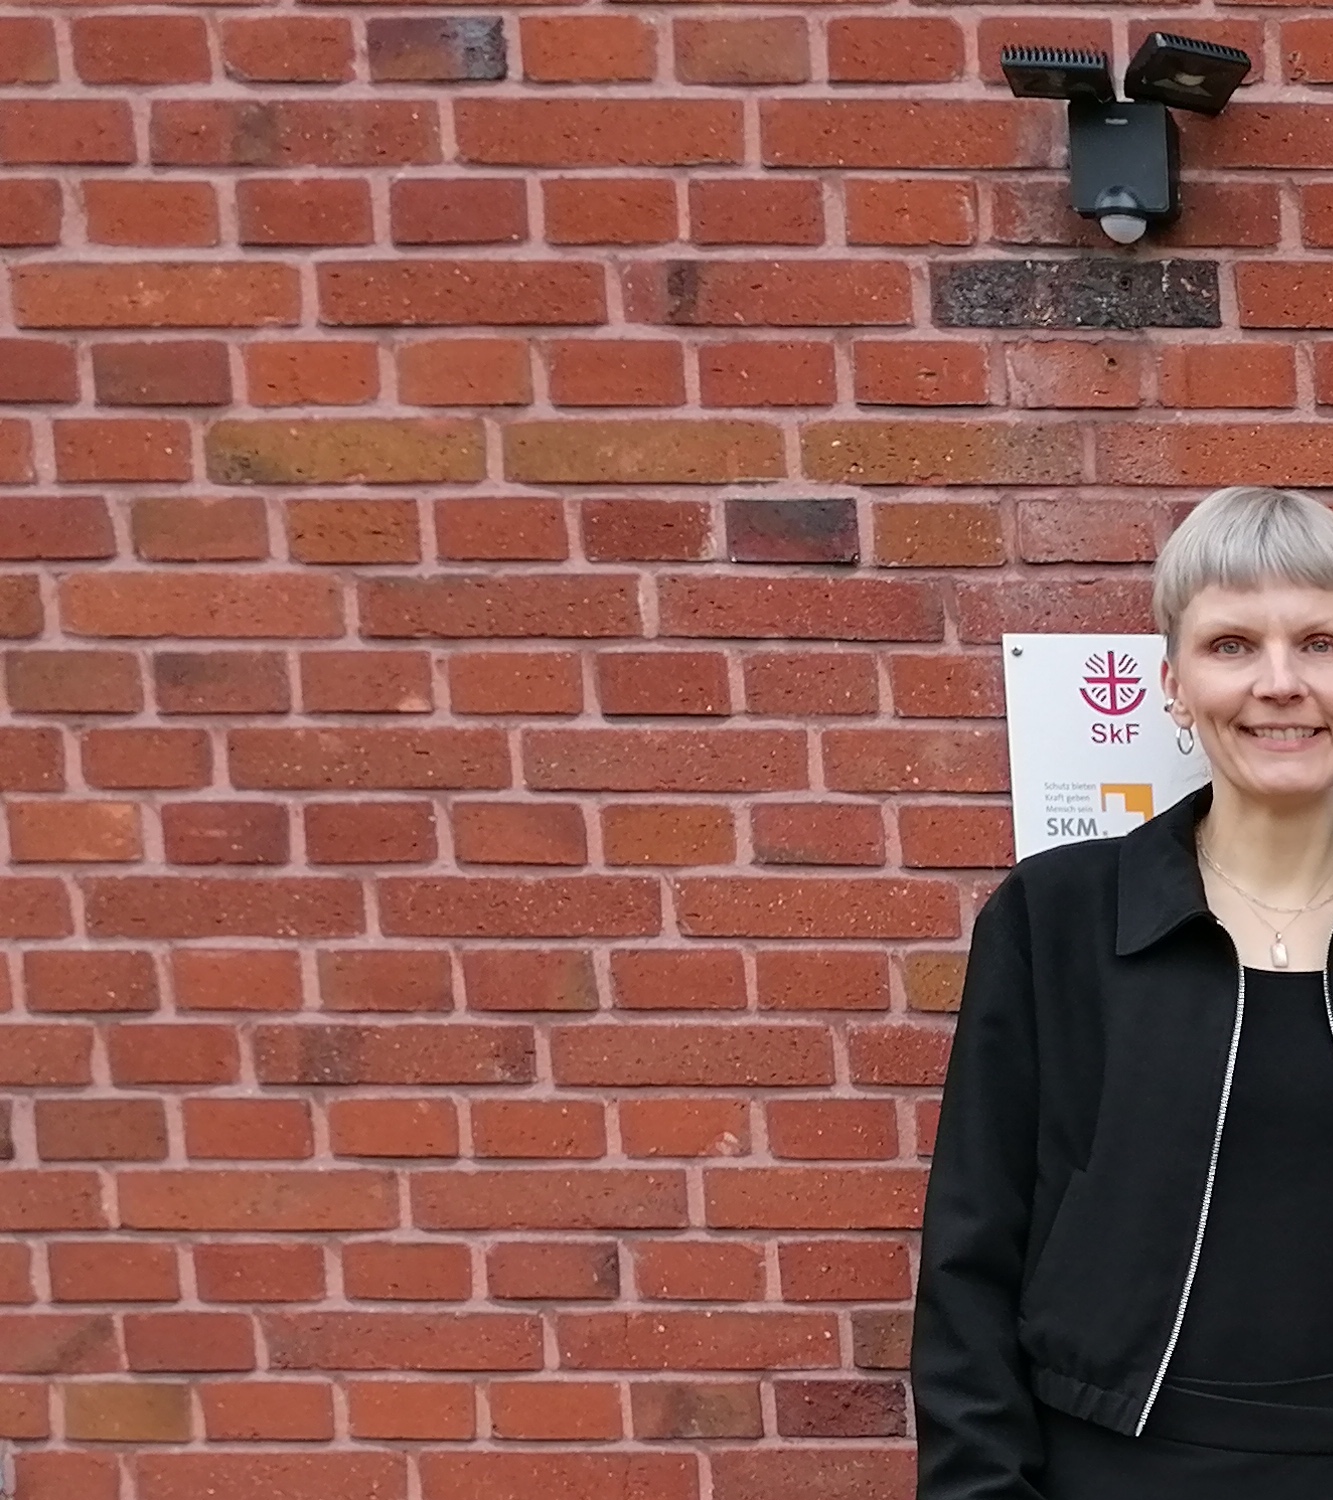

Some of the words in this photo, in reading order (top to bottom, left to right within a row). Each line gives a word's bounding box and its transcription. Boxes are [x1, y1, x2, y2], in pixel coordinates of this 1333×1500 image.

[1091, 723, 1140, 744] SkF
[1044, 782, 1070, 791] Schutz
[1071, 782, 1097, 790] bieten
[1066, 794, 1090, 804] geben
[1046, 805, 1075, 813] Mensch
[1077, 805, 1093, 813] sein
[1046, 817, 1099, 836] SKM
